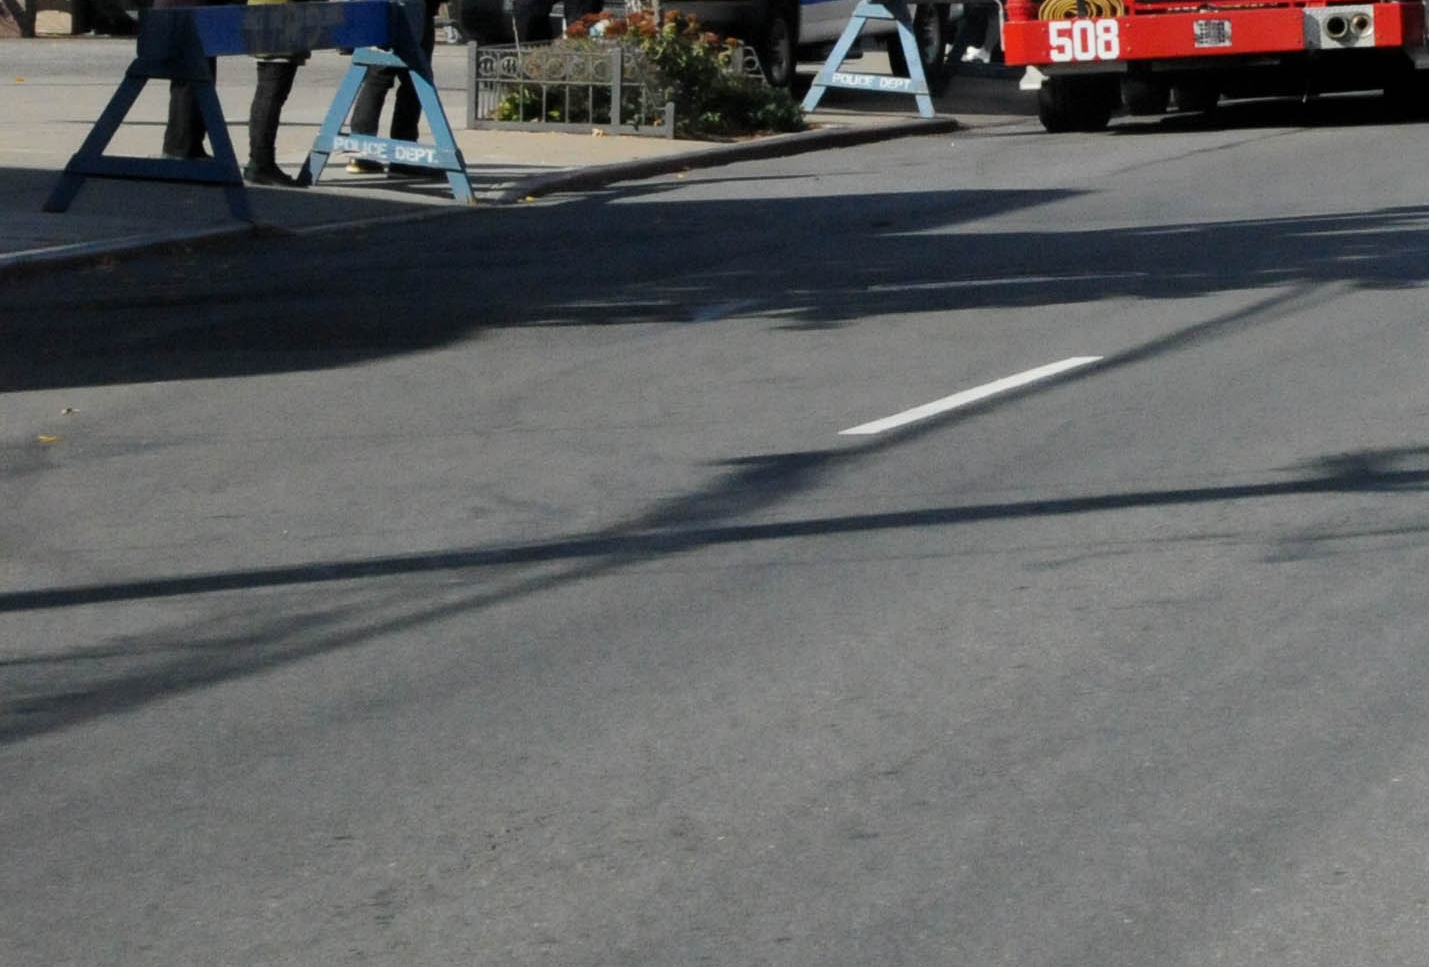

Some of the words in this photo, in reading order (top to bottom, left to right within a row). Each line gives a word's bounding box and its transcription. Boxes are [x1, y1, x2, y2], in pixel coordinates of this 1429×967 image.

[1049, 18, 1121, 62] 508
[832, 72, 873, 86] POLICE
[333, 137, 387, 160] POLICE
[394, 145, 439, 164] DEPT.
